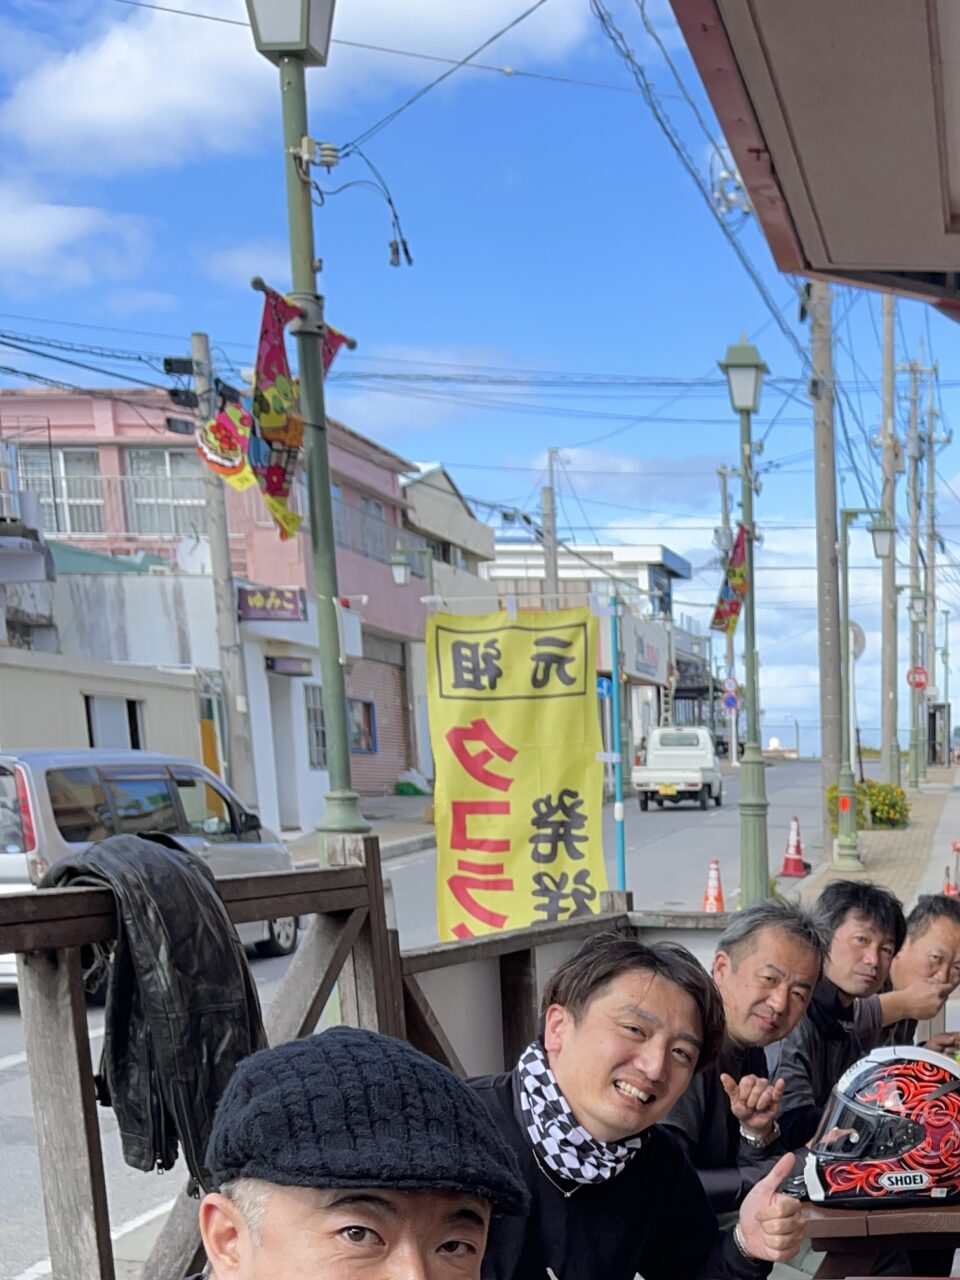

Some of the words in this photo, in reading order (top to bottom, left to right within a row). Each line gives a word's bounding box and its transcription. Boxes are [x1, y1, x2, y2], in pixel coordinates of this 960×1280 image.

[247, 590, 295, 610] ゆみこ
[887, 1174, 923, 1186] SHOEI
